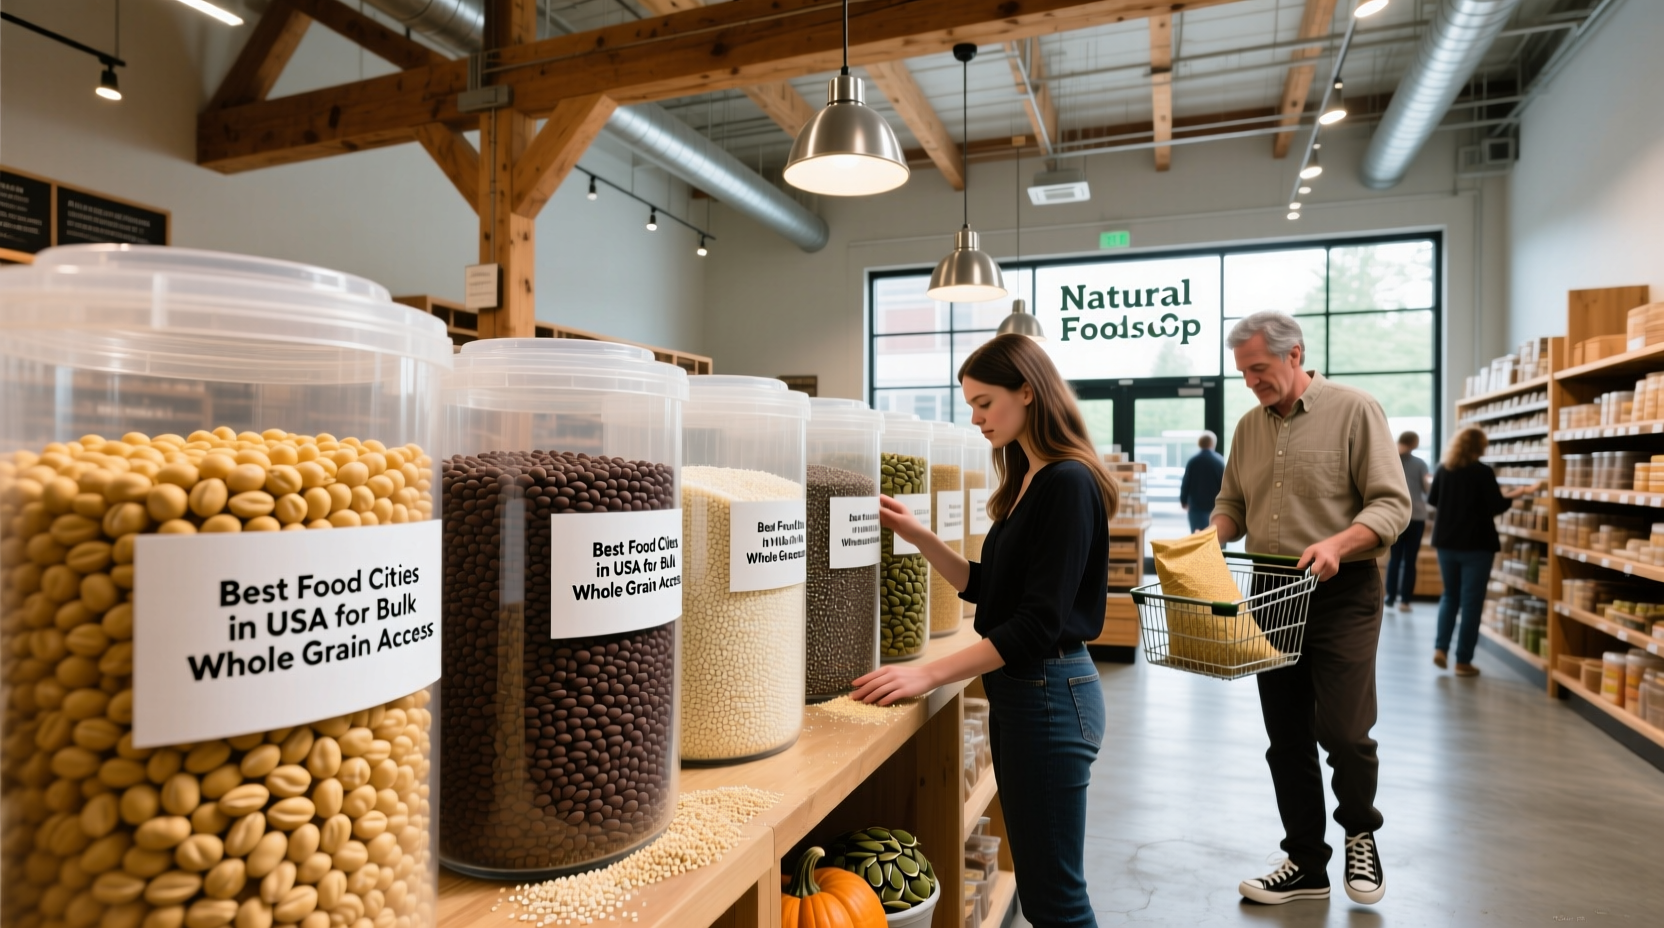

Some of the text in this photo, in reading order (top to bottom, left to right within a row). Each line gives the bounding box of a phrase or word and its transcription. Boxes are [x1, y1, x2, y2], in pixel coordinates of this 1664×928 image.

[1060, 278, 1192, 311] Natural
[593, 542, 624, 557] Best
[629, 538, 655, 554] Food
[597, 562, 609, 577] in
[614, 560, 641, 576] USA
[220, 564, 419, 607] Best Food Cities
[572, 582, 623, 600] Whole
[626, 578, 656, 595] Grain
[229, 593, 416, 641] in USA for Bulk
[187, 623, 433, 681] Whole Grain Access
